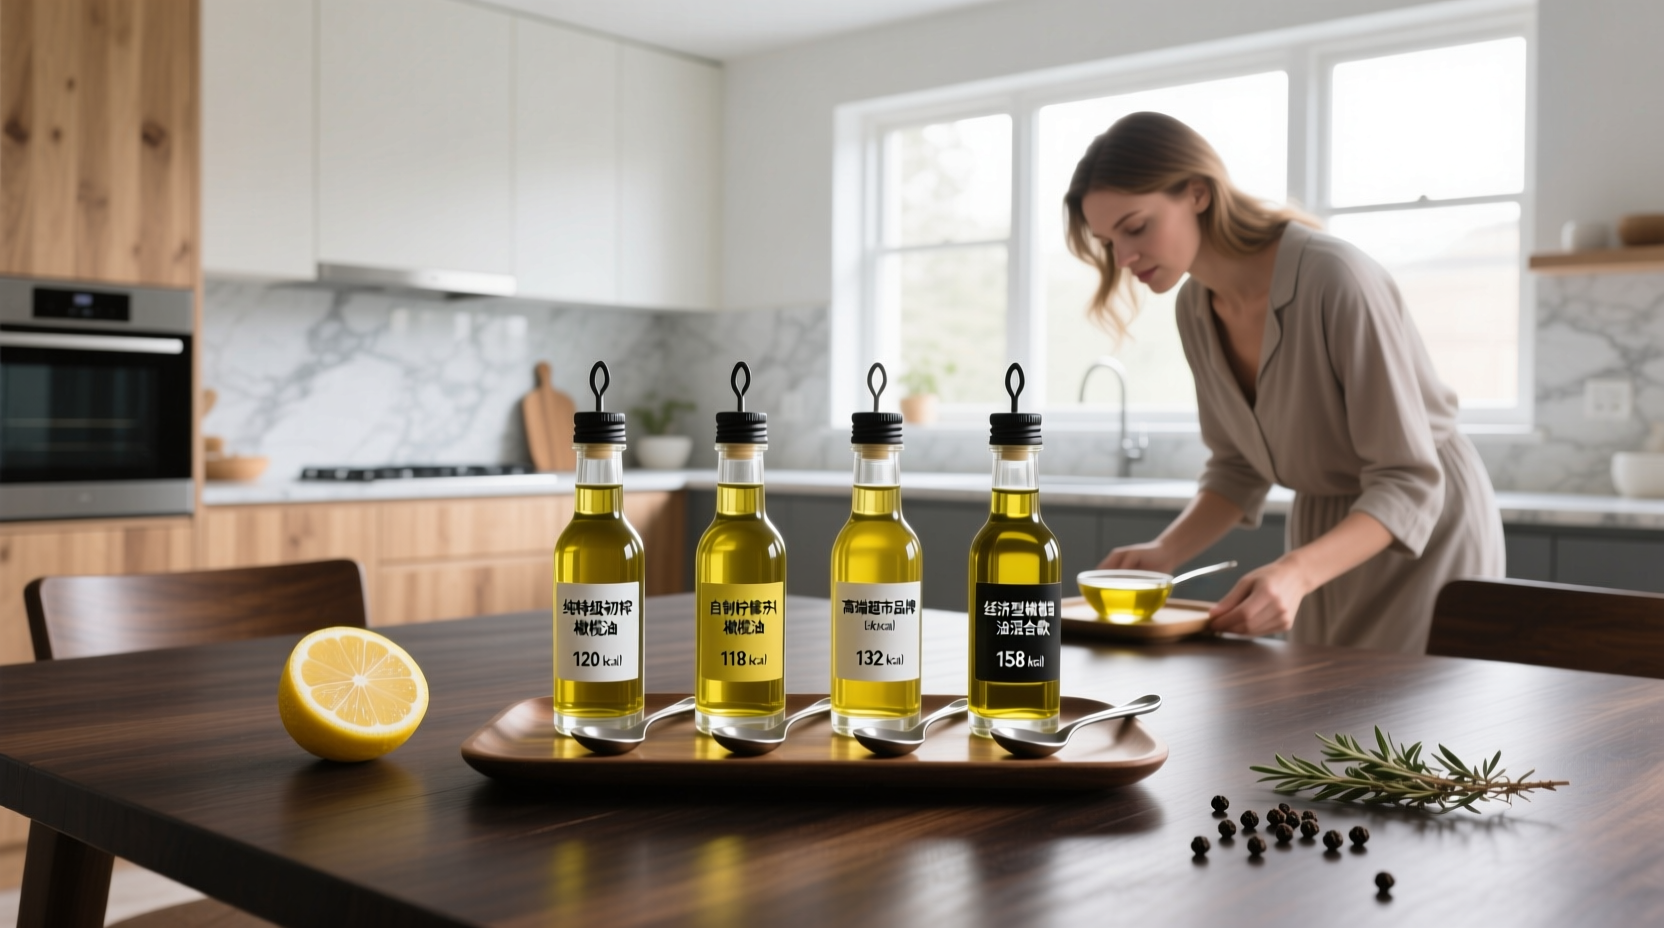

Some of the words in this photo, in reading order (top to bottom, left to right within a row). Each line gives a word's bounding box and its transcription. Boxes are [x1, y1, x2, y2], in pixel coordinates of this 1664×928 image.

[573, 651, 600, 667] 120
[720, 650, 747, 667] 118
[748, 653, 767, 666] kcal
[856, 650, 884, 666] 132
[996, 650, 1025, 668] 158
